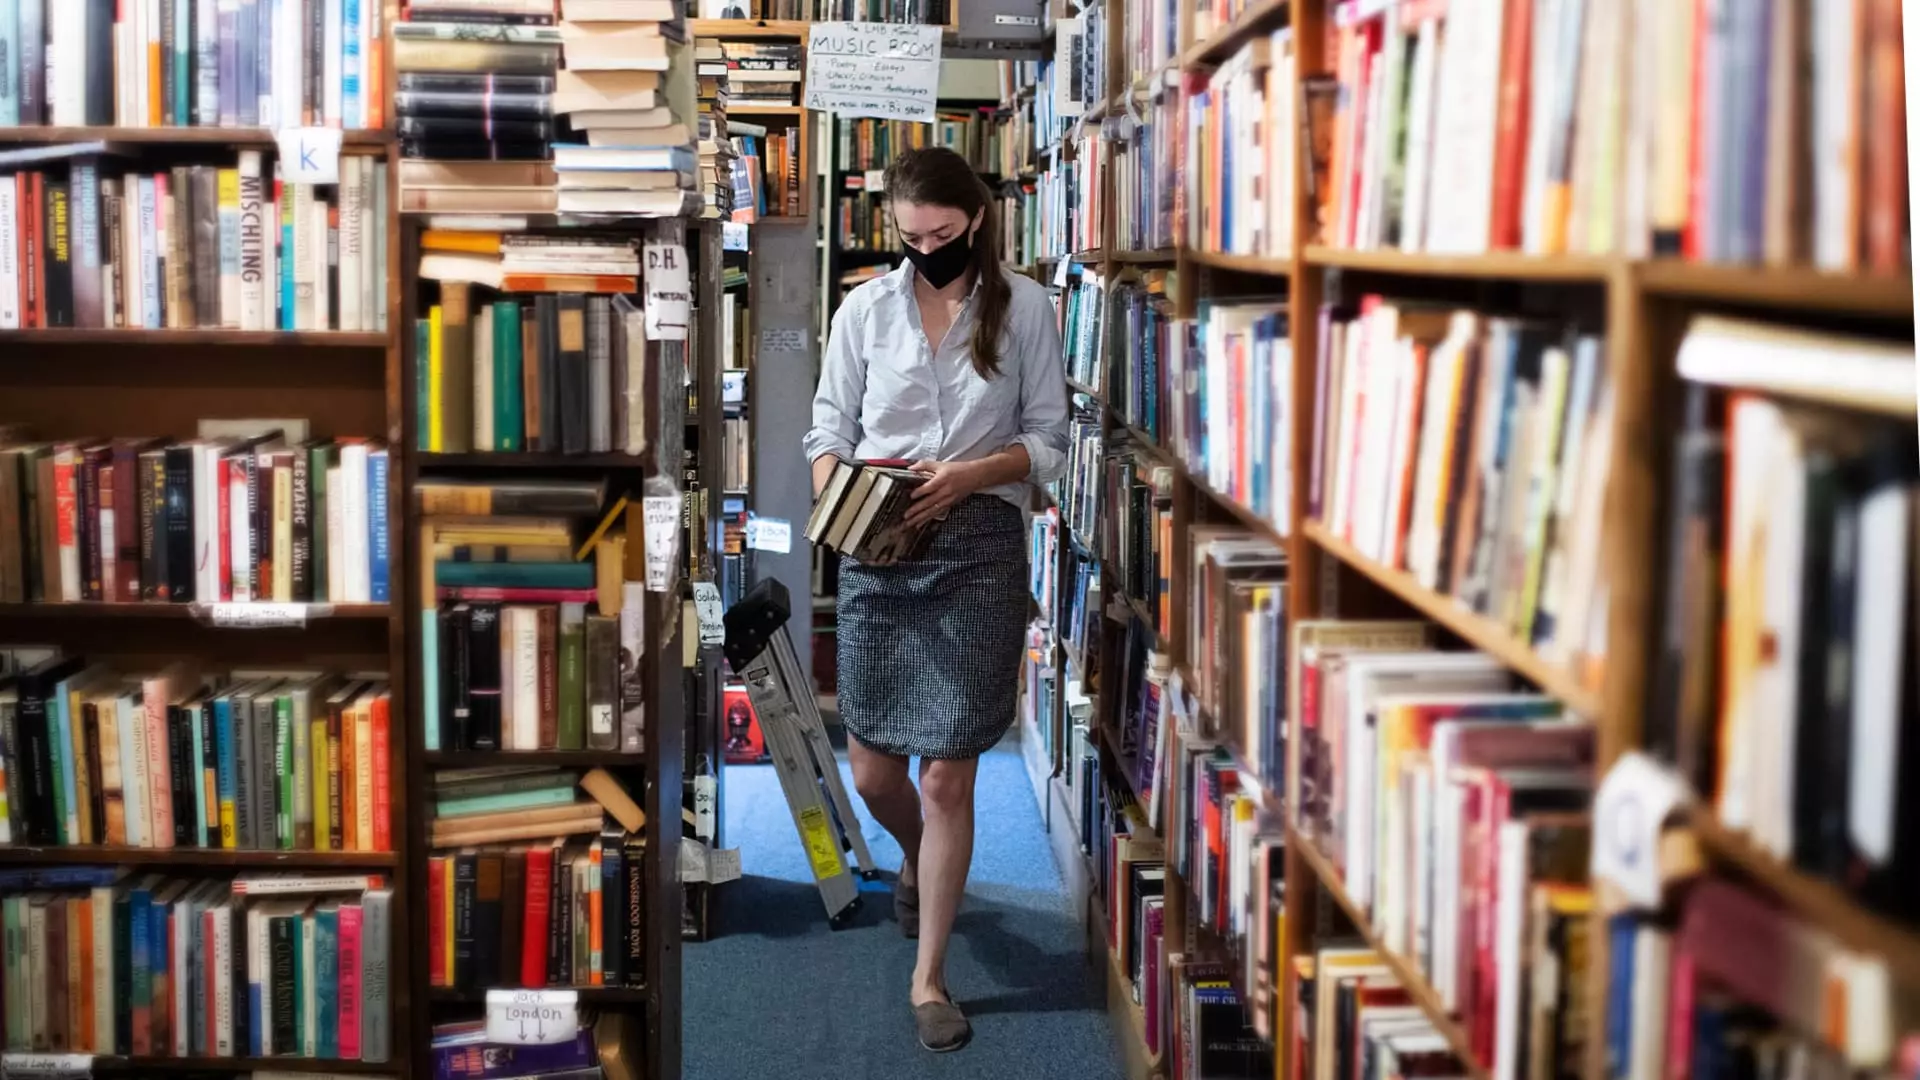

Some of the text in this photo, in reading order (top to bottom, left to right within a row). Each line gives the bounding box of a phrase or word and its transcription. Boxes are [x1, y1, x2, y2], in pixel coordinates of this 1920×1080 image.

[812, 36, 934, 57] MUSIC ROOM
[56, 200, 67, 223] MAN
[240, 175, 262, 283] MISCHLING
[56, 238, 68, 262] LOVE
[648, 248, 679, 270] D.H.
[293, 459, 307, 524] ECSTATIC
[374, 460, 388, 521] INDEPENDENT
[376, 526, 390, 560] PEOPLE
[629, 866, 641, 959] KINGSBLOOD ROYAL
[512, 991, 544, 1004] Jack
[506, 1006, 563, 1022] London
